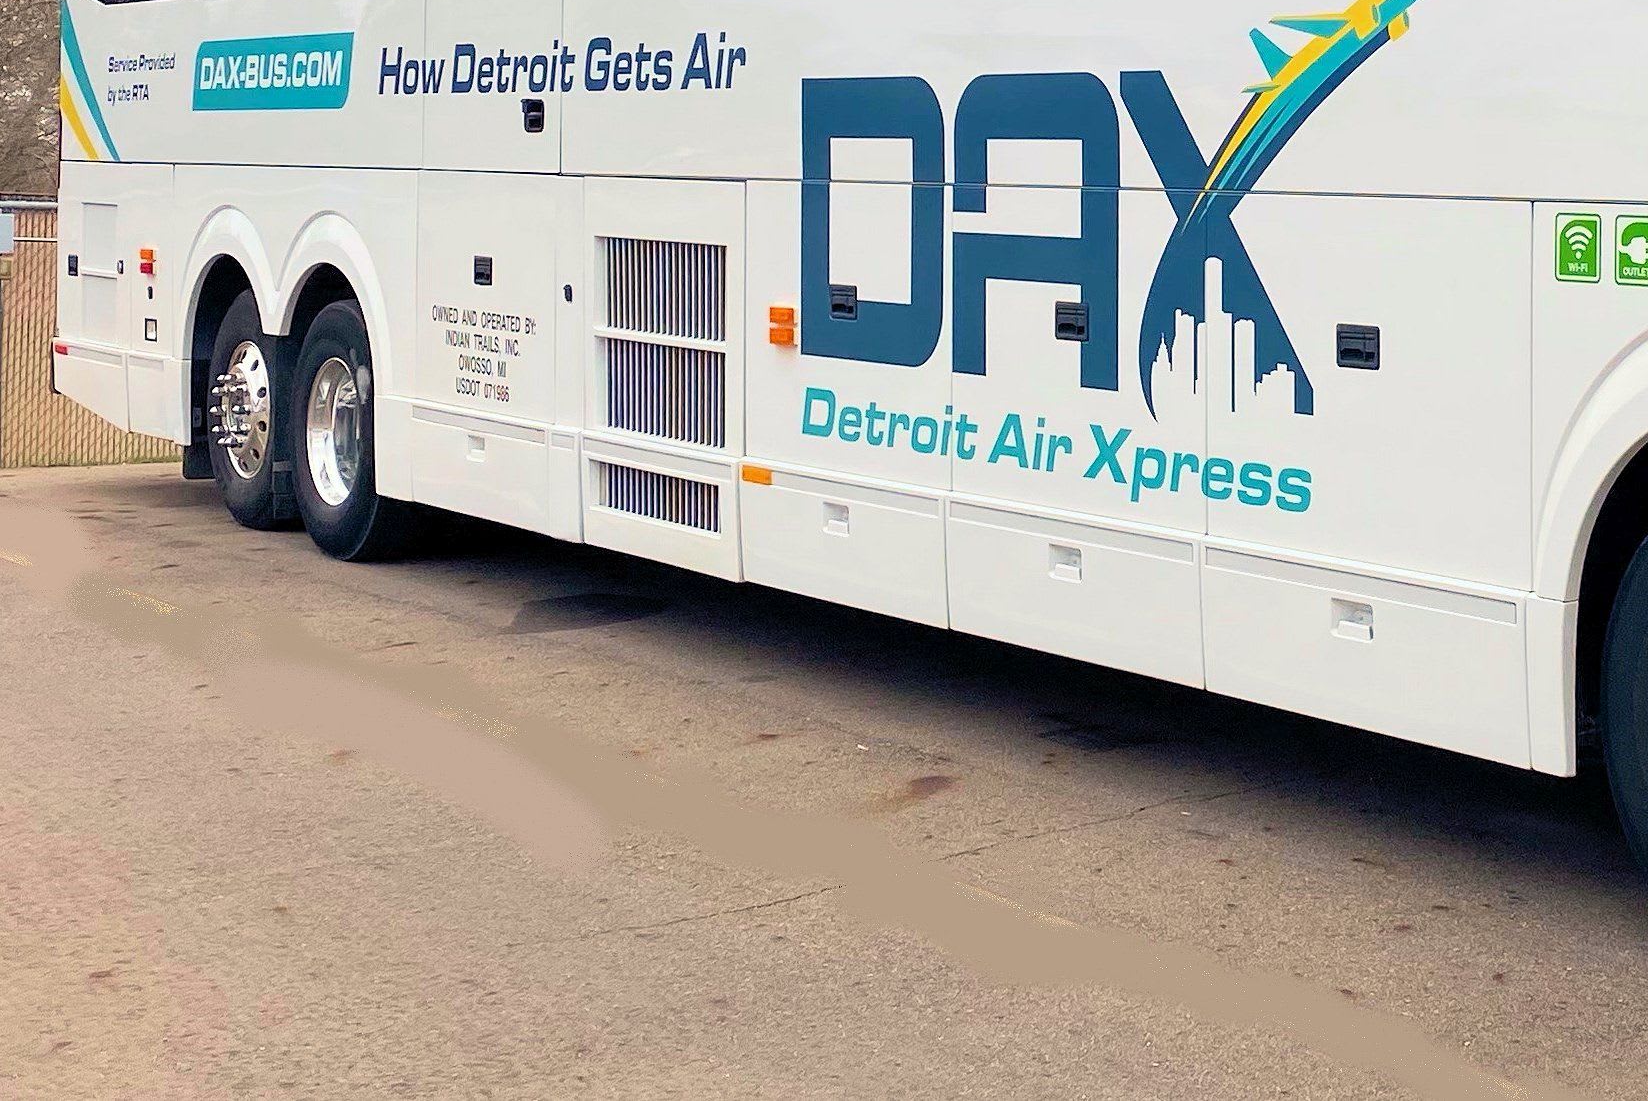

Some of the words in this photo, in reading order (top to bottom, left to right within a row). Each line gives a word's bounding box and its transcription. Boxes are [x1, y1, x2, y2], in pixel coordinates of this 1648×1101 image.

[108, 55, 138, 72] Service
[139, 52, 176, 71] Provided
[200, 50, 344, 90] DAX-BUS.COM
[379, 46, 445, 94] How
[451, 40, 576, 94] Detroit
[585, 37, 673, 92] Gets
[680, 31, 746, 90] Air
[107, 85, 116, 106] by
[118, 85, 131, 101] the
[132, 84, 149, 100] RTA
[801, 70, 1313, 422] DAX
[431, 304, 459, 324] OWNED
[461, 309, 477, 327] AND
[480, 311, 521, 333] OPERATED
[524, 317, 537, 336] BY:
[445, 329, 470, 349] INDIAN
[473, 334, 502, 356] TRAILS,
[504, 338, 521, 357] INC.
[458, 354, 494, 377] OWOSSO,
[497, 360, 507, 378] MI
[455, 376, 481, 398] USDOT
[802, 386, 977, 460] Detroit
[988, 413, 1072, 472] Air
[1083, 424, 1314, 513] Xpress
